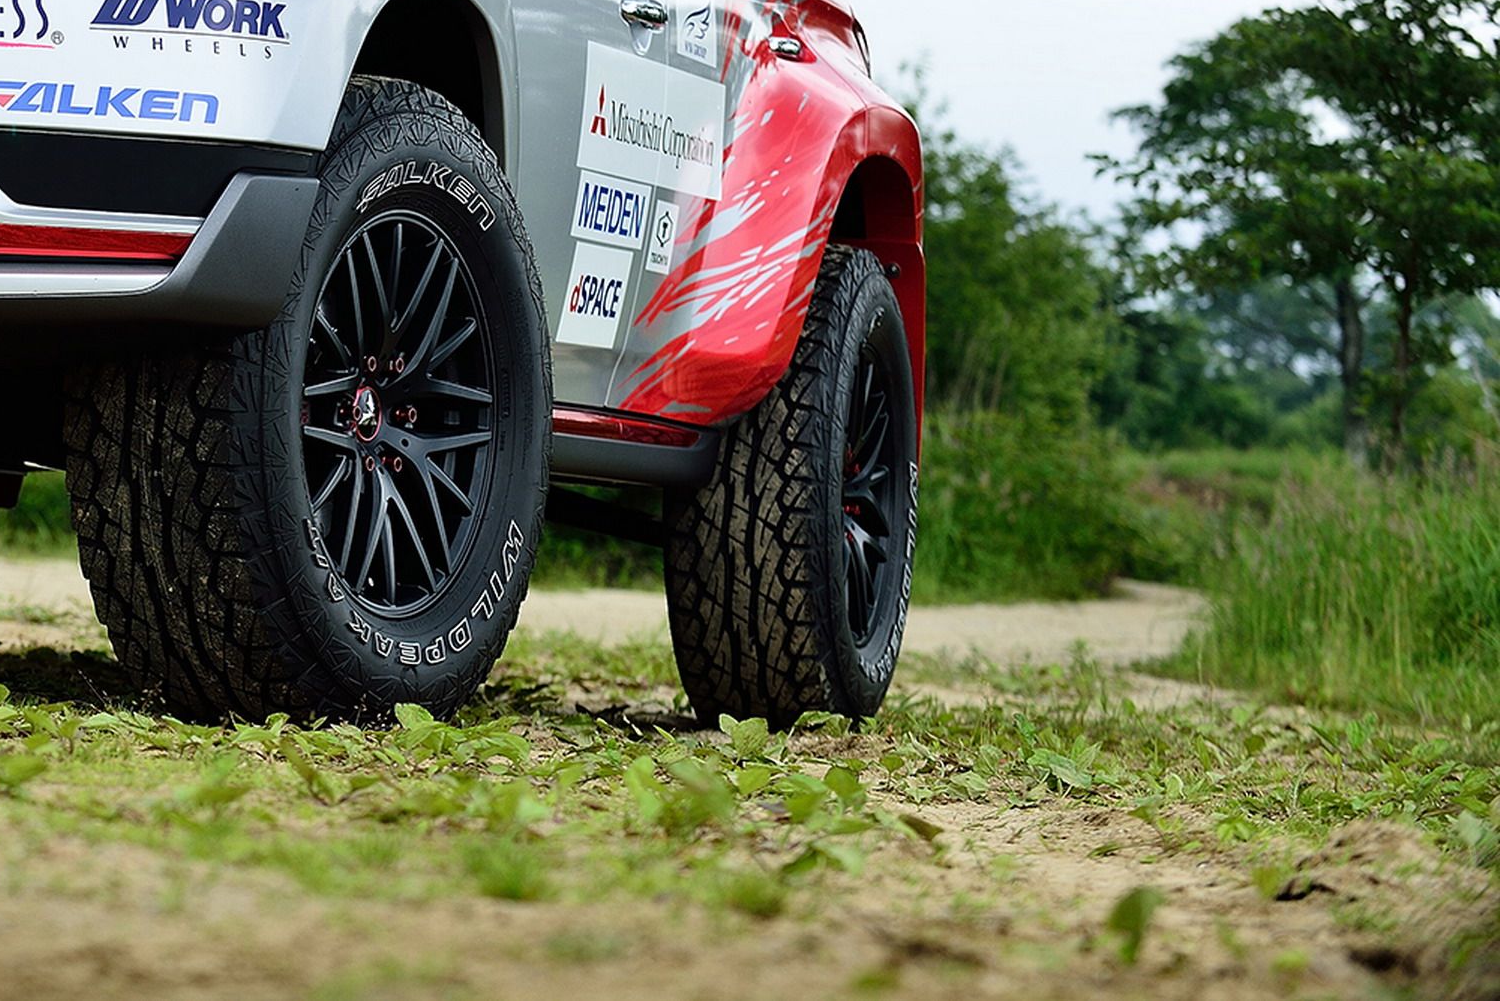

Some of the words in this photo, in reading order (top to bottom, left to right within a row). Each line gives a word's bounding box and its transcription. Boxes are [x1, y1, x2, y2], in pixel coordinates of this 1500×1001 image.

[112, 35, 273, 59] WHEELS
[608, 99, 662, 152] Mitsubishi
[662, 115, 714, 170] Corporation
[355, 161, 498, 232] FALKEN
[578, 182, 646, 239] MEIDEN
[569, 275, 623, 319] dSPACE
[349, 519, 524, 665] WILDPEAK
